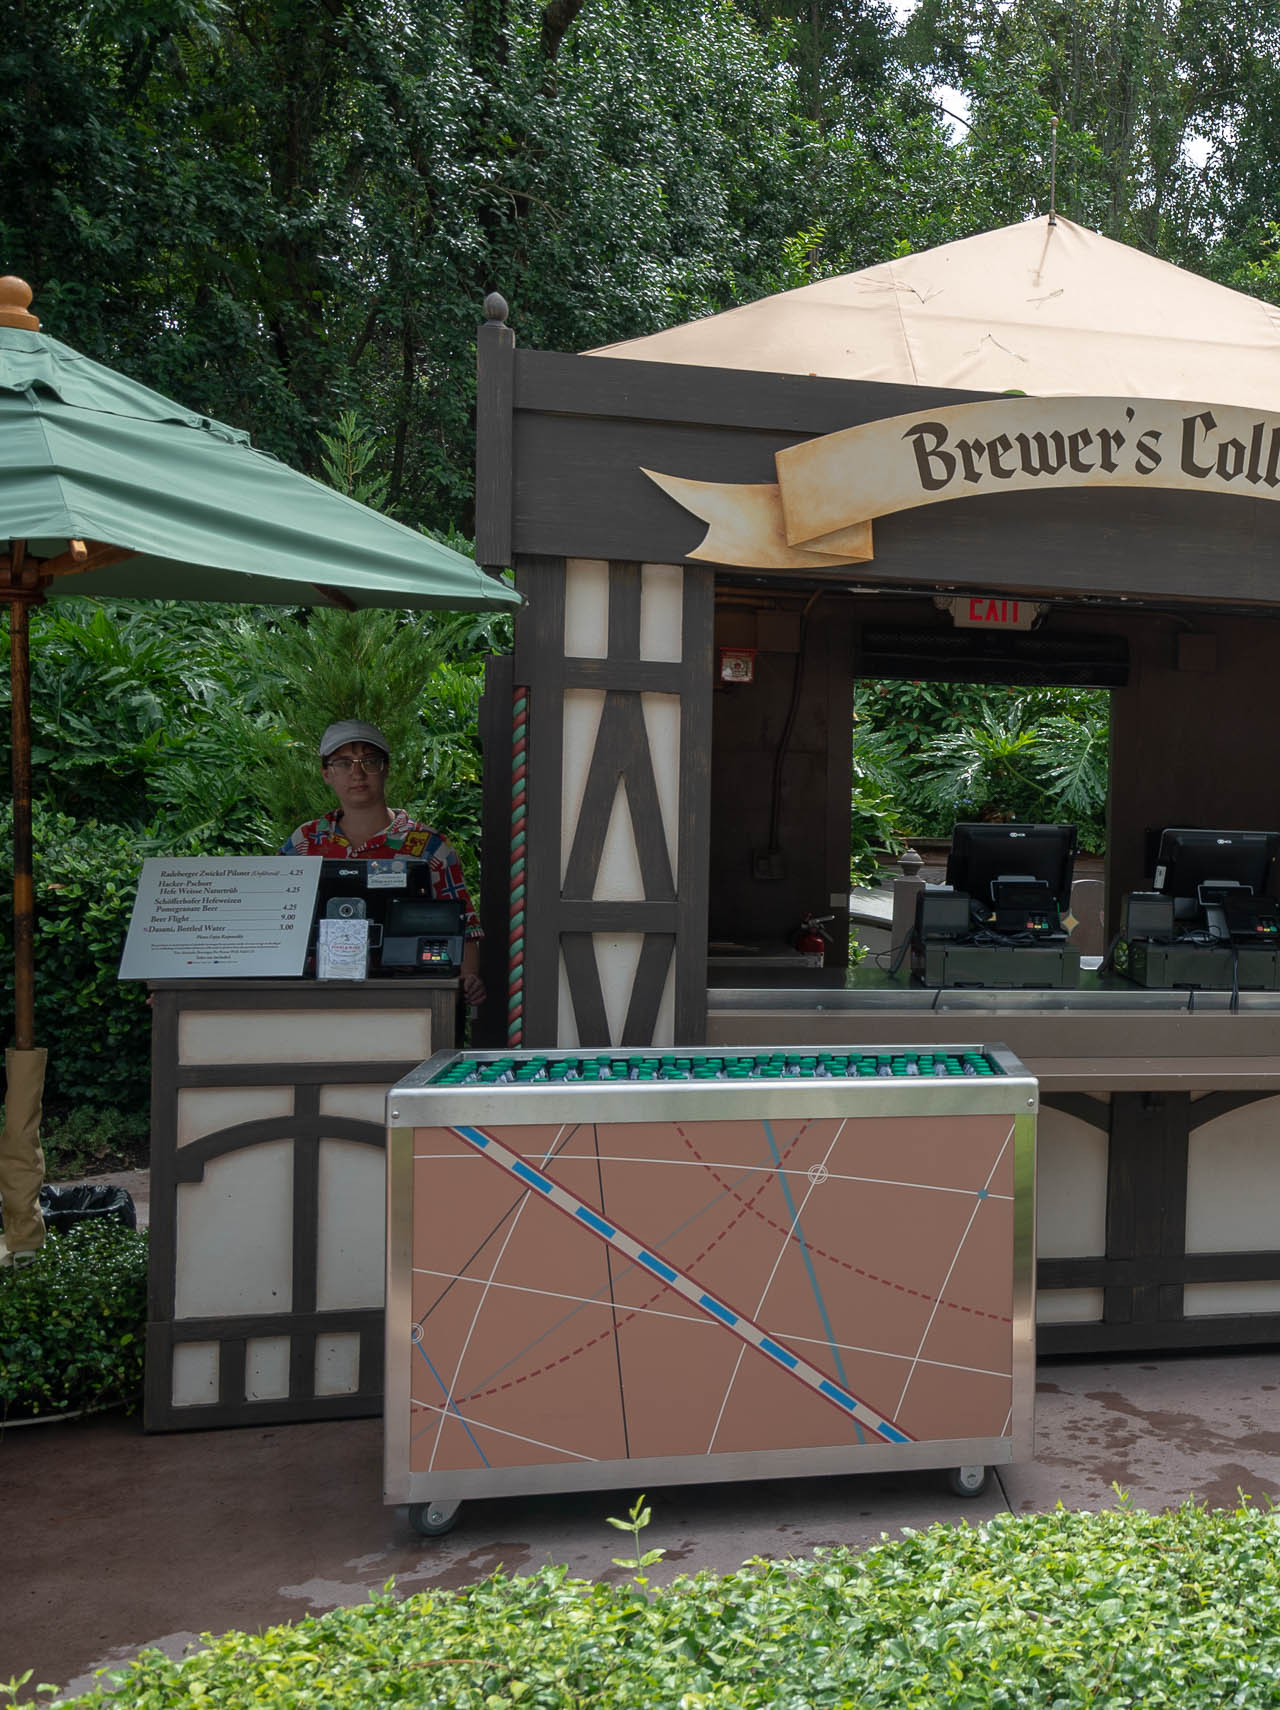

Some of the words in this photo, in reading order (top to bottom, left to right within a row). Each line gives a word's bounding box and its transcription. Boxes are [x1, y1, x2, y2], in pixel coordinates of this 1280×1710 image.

[901, 407, 1163, 491] Brewer's
[178, 887, 202, 895] Weisse
[282, 903, 297, 911] 4.25
[150, 915, 166, 923] Beer
[167, 914, 190, 923] Flight
[177, 925, 203, 933] Bottled
